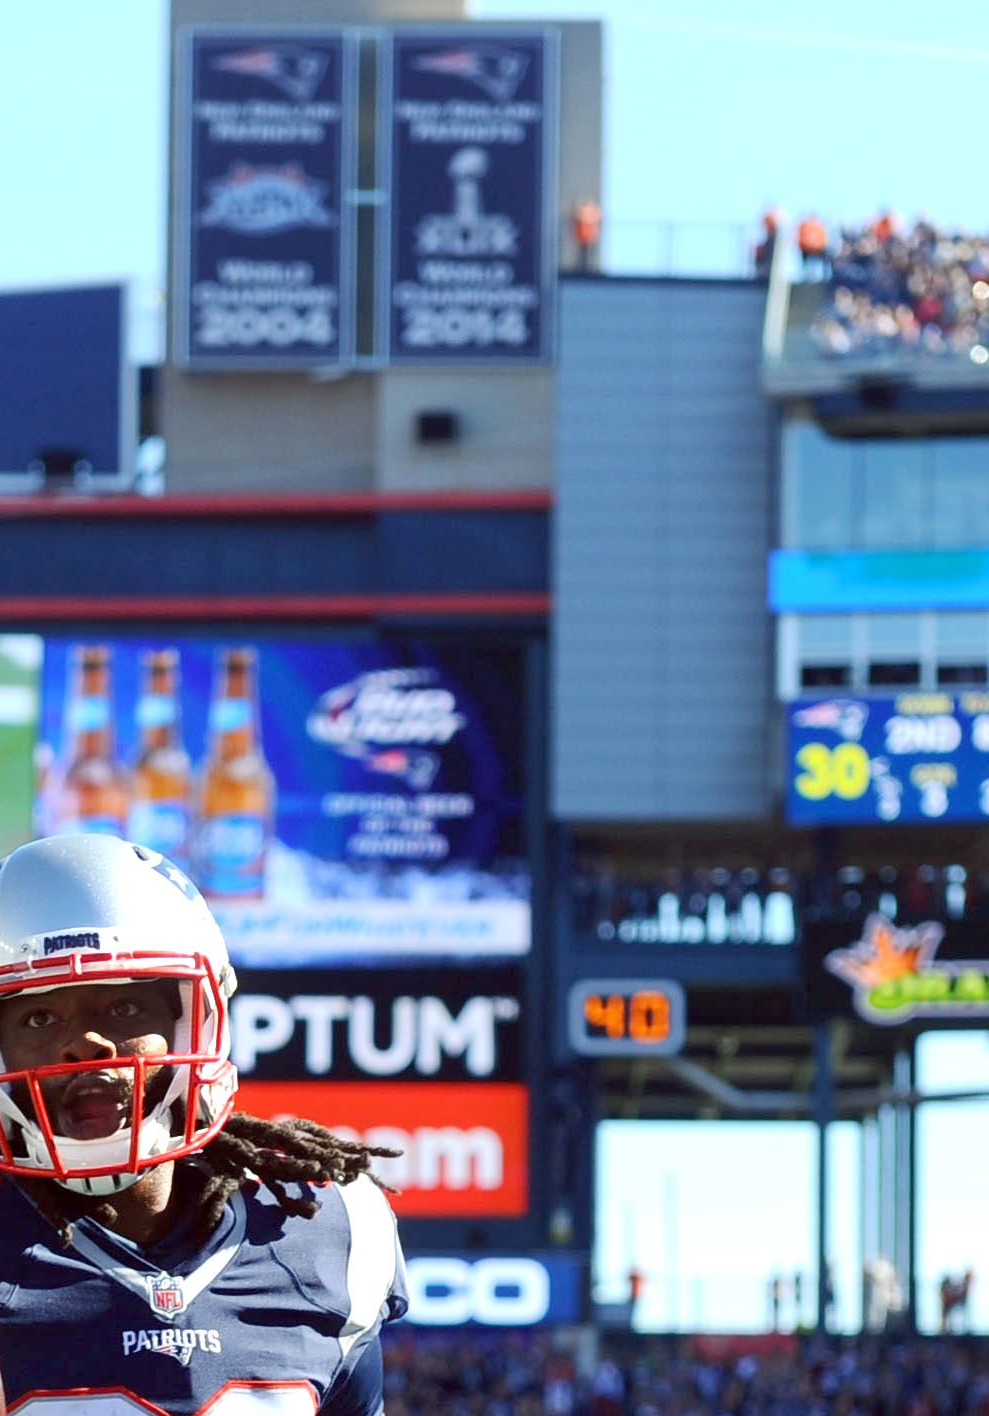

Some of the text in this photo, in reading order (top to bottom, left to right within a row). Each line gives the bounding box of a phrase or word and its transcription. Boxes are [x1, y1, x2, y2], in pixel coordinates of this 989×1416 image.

[197, 307, 335, 347] 2004
[402, 307, 528, 347] 2014
[794, 741, 871, 802] 30
[43, 932, 101, 956] PATRIOTS
[231, 994, 498, 1078] PTUM
[584, 992, 671, 1045] 40
[156, 1291, 181, 1309] NFL
[122, 1328, 222, 1356] PATRIOTS
